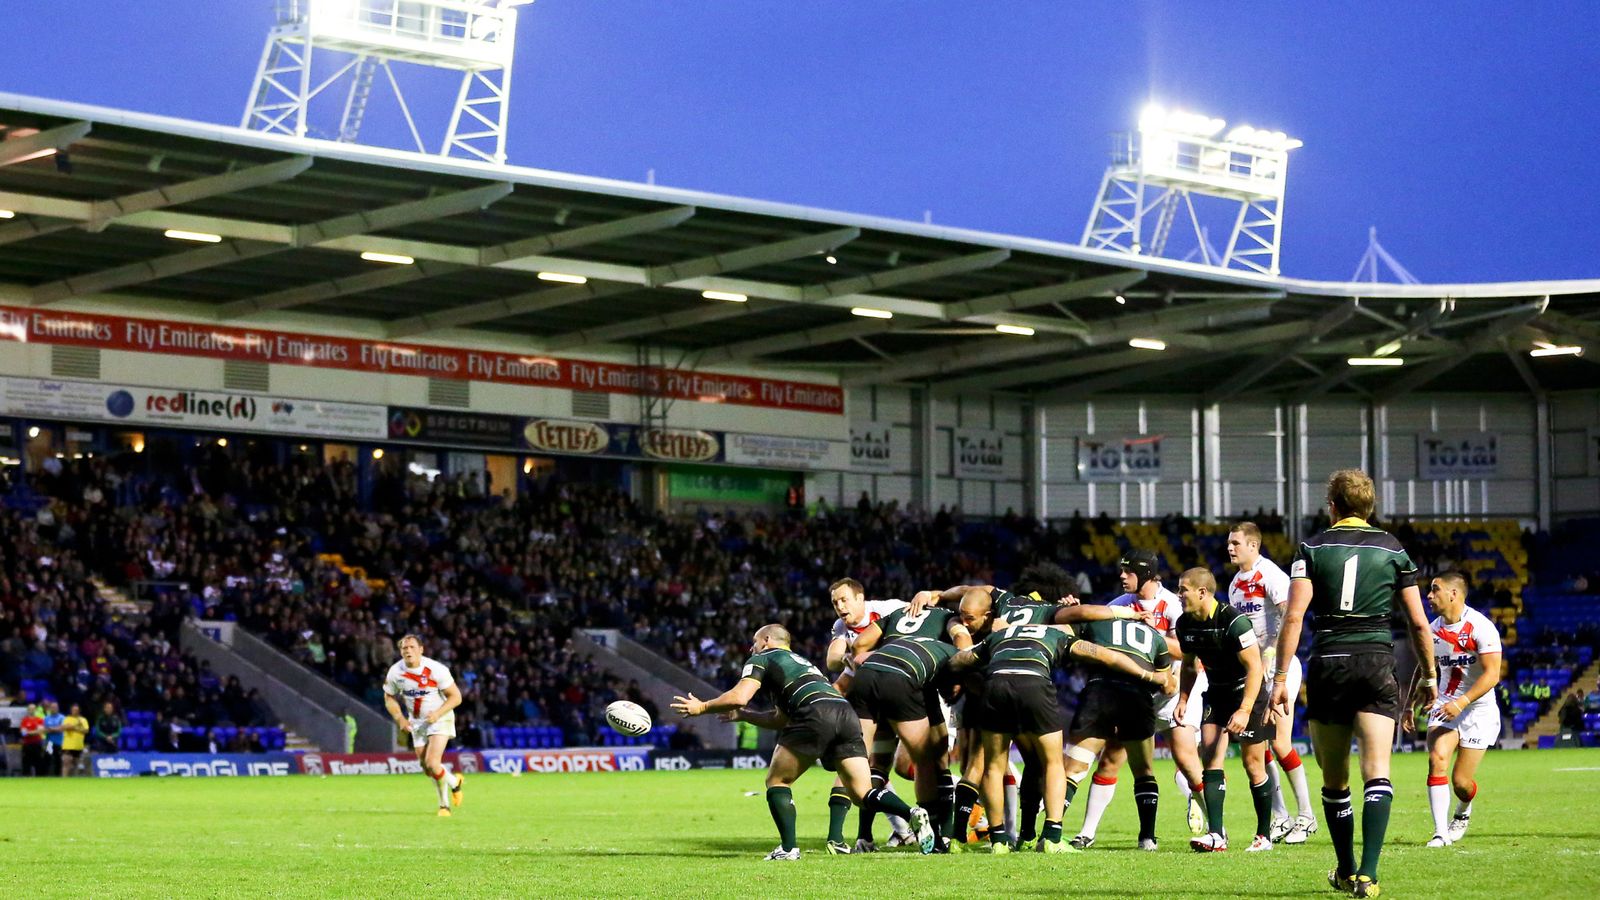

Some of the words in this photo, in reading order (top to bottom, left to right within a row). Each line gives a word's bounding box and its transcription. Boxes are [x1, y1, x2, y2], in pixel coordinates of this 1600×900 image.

[33, 314, 112, 340] Emirates
[126, 322, 155, 348] Fly
[160, 325, 234, 351] Emirates
[246, 333, 272, 359] Fly
[277, 335, 348, 362] Emirates
[361, 344, 388, 369] Fly
[391, 347, 459, 372] Emirates
[468, 354, 494, 378] Fly
[496, 357, 561, 381] Emirates
[571, 364, 595, 388] Fly
[693, 376, 750, 399] Emirates
[761, 383, 784, 406] Fly
[786, 385, 840, 408] Emirates
[427, 415, 511, 432] SPECTRUM
[849, 429, 890, 459] otal
[957, 436, 1004, 465] Total
[1084, 440, 1160, 469] Total
[1424, 437, 1496, 466] Total
[1340, 555, 1358, 611] 1
[895, 608, 931, 634] 8
[1112, 620, 1153, 653] 10
[608, 712, 637, 731] STEEDEN
[489, 753, 523, 773] sky
[528, 752, 615, 772] SPORTS
[618, 754, 645, 771] HD
